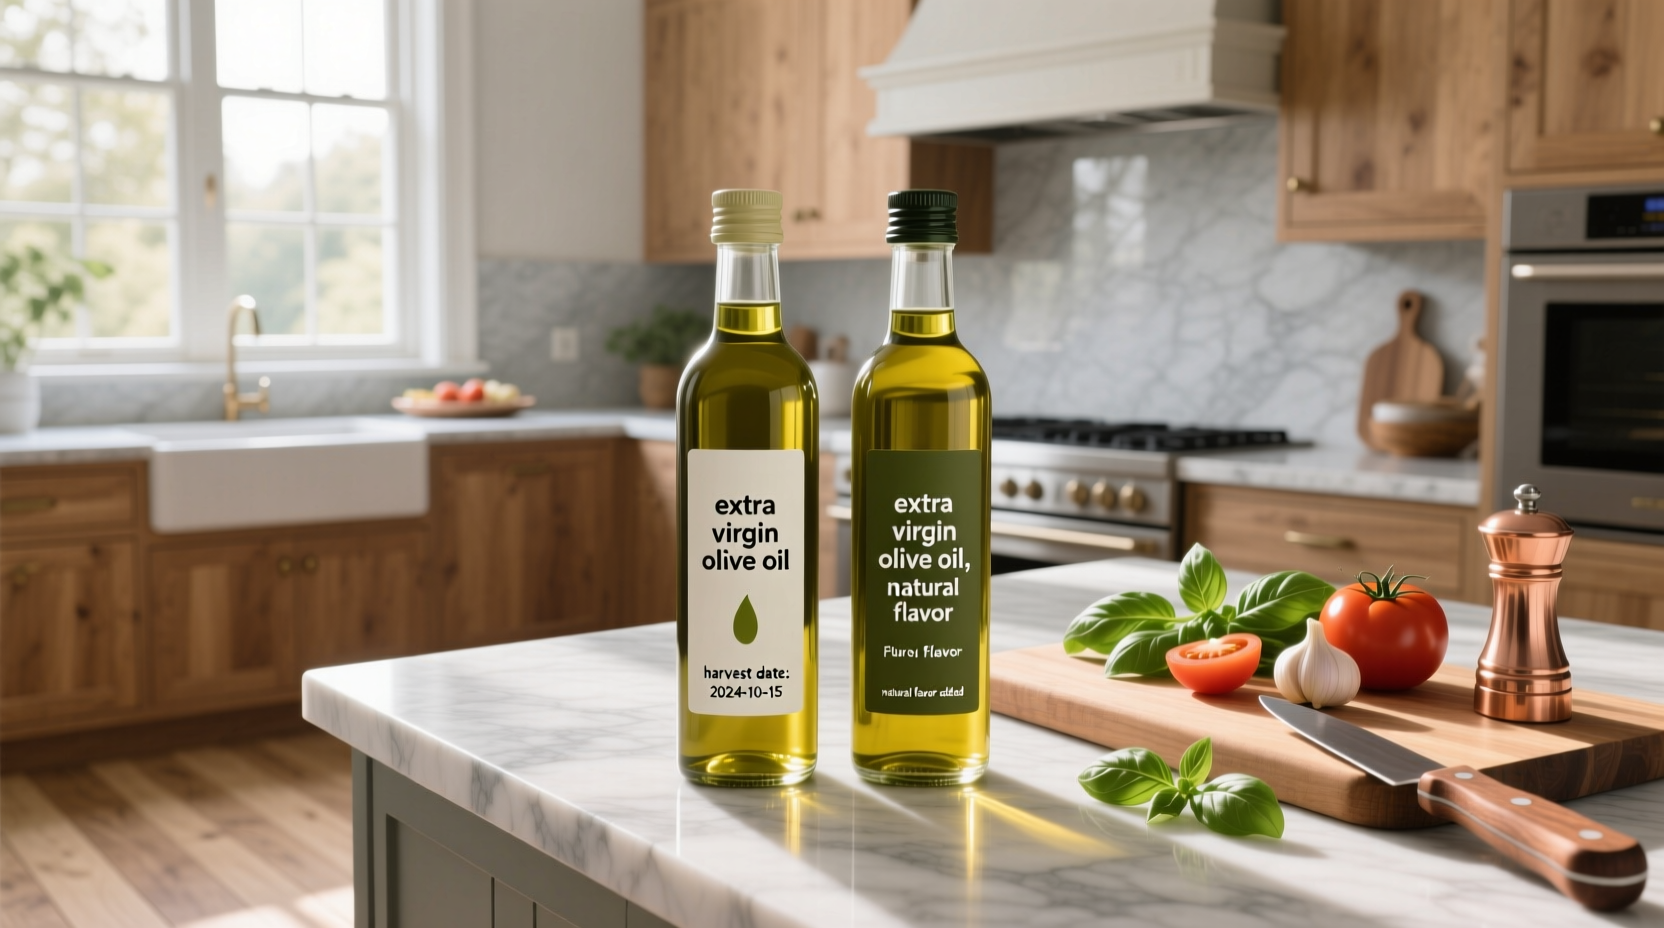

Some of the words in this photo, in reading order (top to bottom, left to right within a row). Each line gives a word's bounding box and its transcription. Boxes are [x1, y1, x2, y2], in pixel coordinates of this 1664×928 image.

[714, 495, 776, 515] extra
[894, 494, 953, 513] extra
[711, 521, 779, 549] virgin
[892, 519, 957, 547] virgin
[702, 548, 756, 571] olive
[762, 548, 790, 571] oil
[878, 547, 932, 569] olive
[937, 547, 971, 573] oil,
[887, 577, 959, 597] natural
[893, 601, 954, 622] flavor
[923, 644, 963, 658] Flavor
[703, 664, 752, 680] harvest
[756, 664, 790, 679] date:
[710, 685, 783, 698] 2024-10-15
